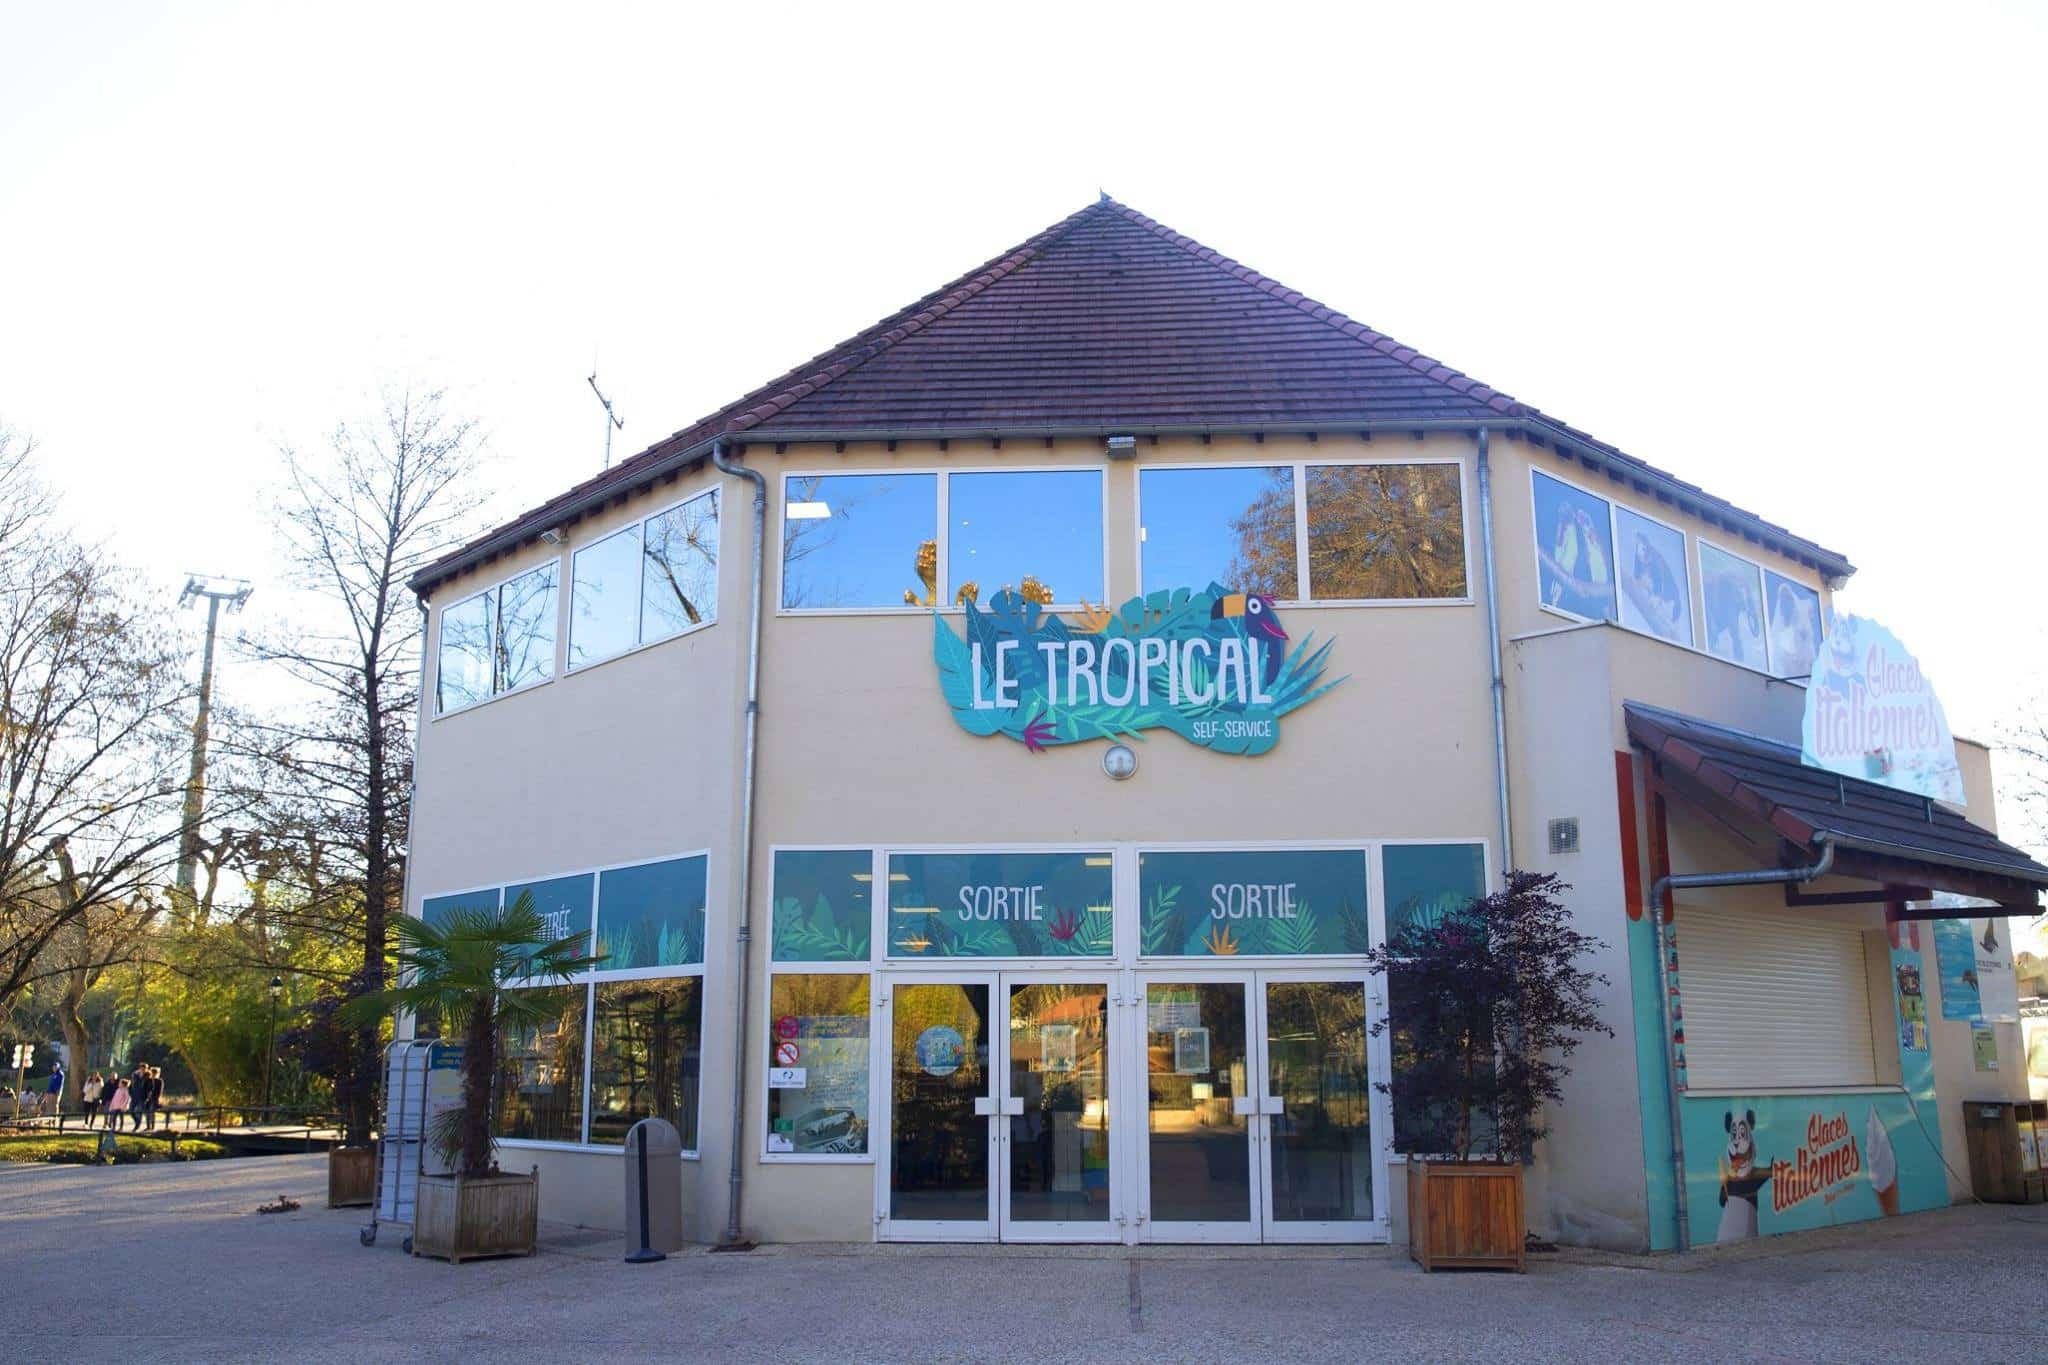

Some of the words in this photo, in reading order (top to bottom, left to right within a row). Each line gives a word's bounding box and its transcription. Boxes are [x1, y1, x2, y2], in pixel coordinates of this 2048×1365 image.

[971, 641, 1019, 710] LE
[1038, 638, 1272, 706] TROPICAL
[1867, 645, 1922, 698] Glaces
[1193, 720, 1272, 739] SELF-SERVICE
[959, 885, 1043, 921] SORTIE
[1211, 883, 1297, 918] SORTIE
[1808, 1111, 1848, 1153] Glaces
